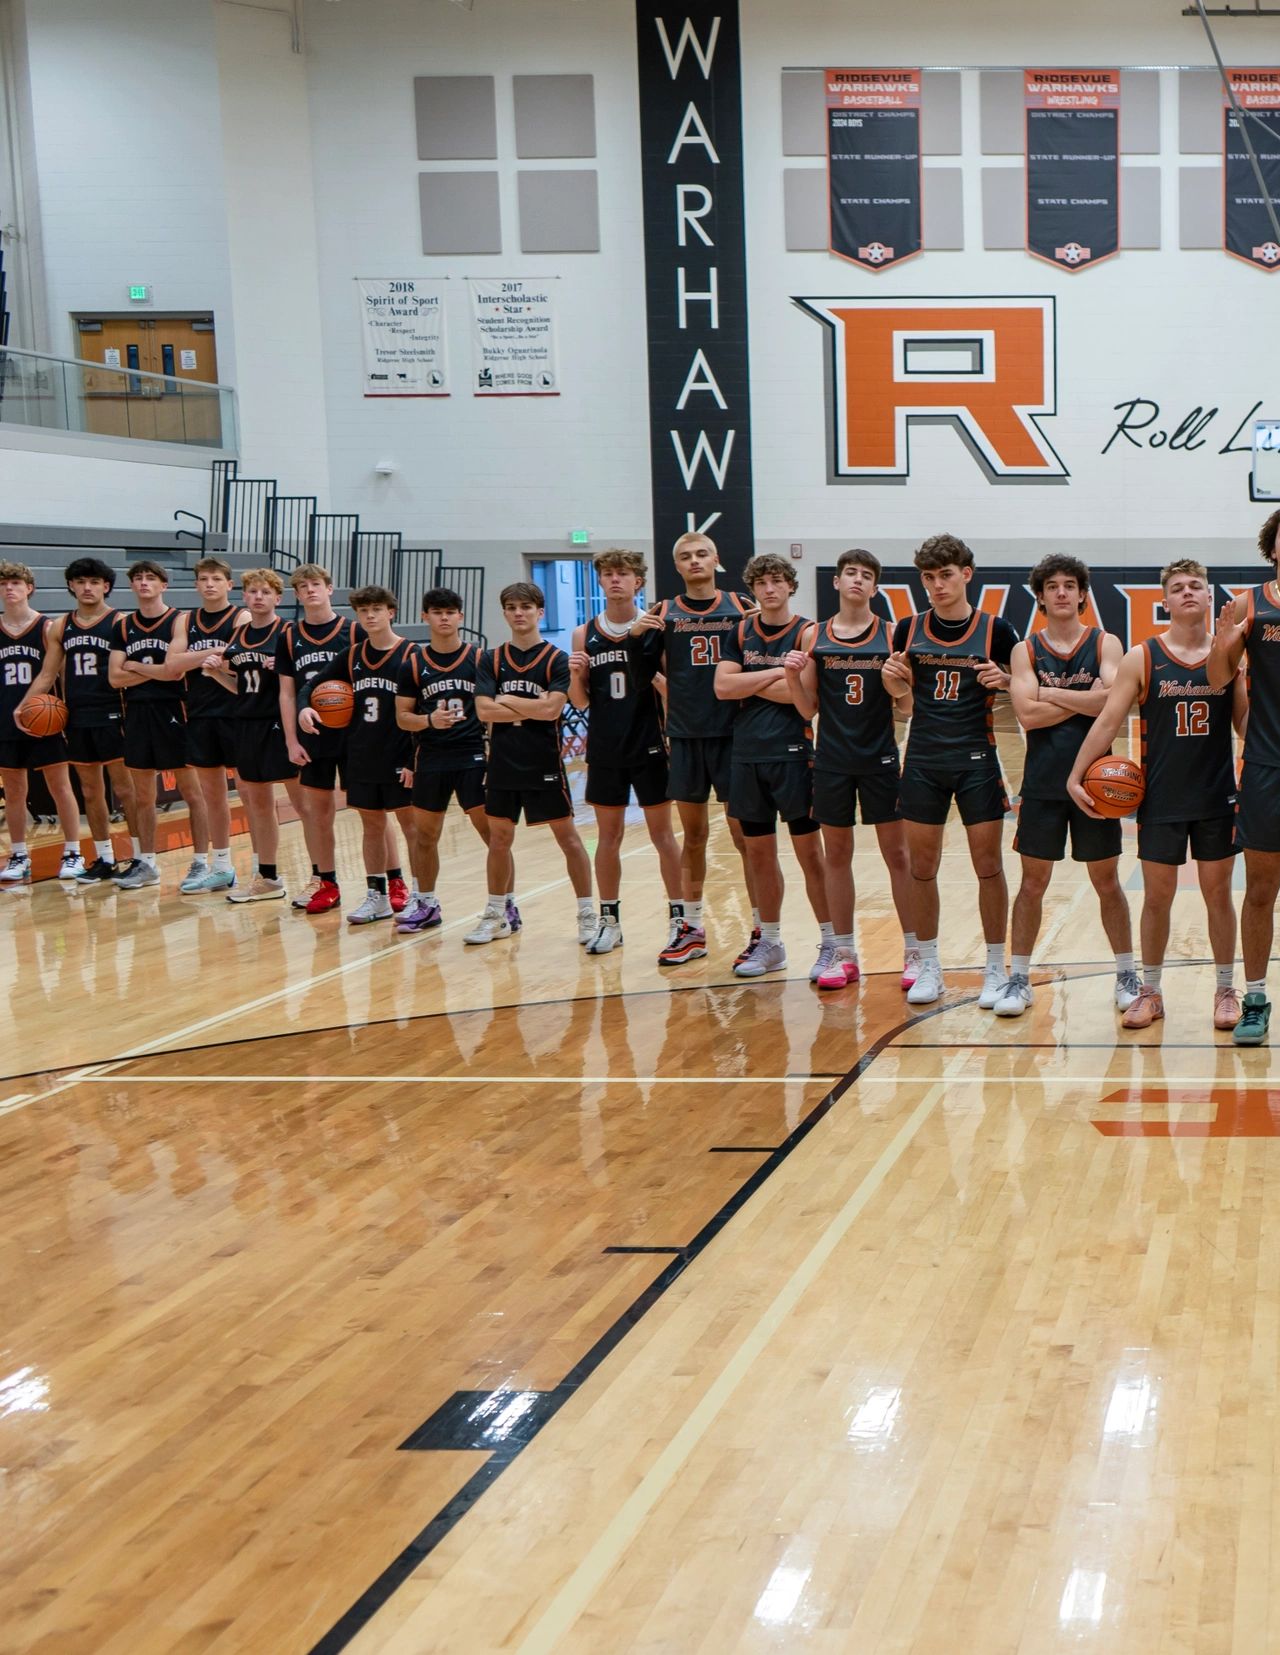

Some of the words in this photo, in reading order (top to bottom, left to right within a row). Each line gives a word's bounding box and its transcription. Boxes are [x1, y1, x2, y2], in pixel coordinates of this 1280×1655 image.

[834, 74, 912, 83] RIDGEVUE
[1034, 74, 1111, 83] RIDGEVUE
[827, 83, 919, 93] WARHAWKS
[1026, 84, 1118, 93] WARHAWKS
[843, 95, 903, 105] BASKETBALL
[1047, 96, 1098, 105] WRESTLING
[654, 16, 735, 534] WARHAW
[389, 282, 415, 293] 2018
[501, 283, 523, 292] 2017
[366, 295, 395, 307] Spirit
[398, 295, 408, 305] of
[412, 295, 439, 307] Sport
[478, 294, 548, 304] Interscholastic
[390, 307, 419, 316] Award
[503, 305, 523, 314] Star
[507, 316, 551, 325] Recognition
[789, 296, 1071, 485] R
[1101, 397, 1219, 455] Roll
[673, 617, 734, 633] Warhawks
[126, 638, 169, 656] RIDGEVUE
[690, 635, 722, 666] 21
[74, 653, 98, 676] 12
[295, 651, 338, 671] RIDGEV
[822, 656, 884, 671] Warhawks
[4, 662, 32, 685] 20
[243, 670, 261, 693] 11
[421, 678, 475, 700] RIDGEVUE
[610, 672, 626, 699] 0
[845, 673, 864, 705] 3
[933, 670, 961, 701] 11
[363, 697, 380, 722] 3
[1176, 701, 1210, 737] 12
